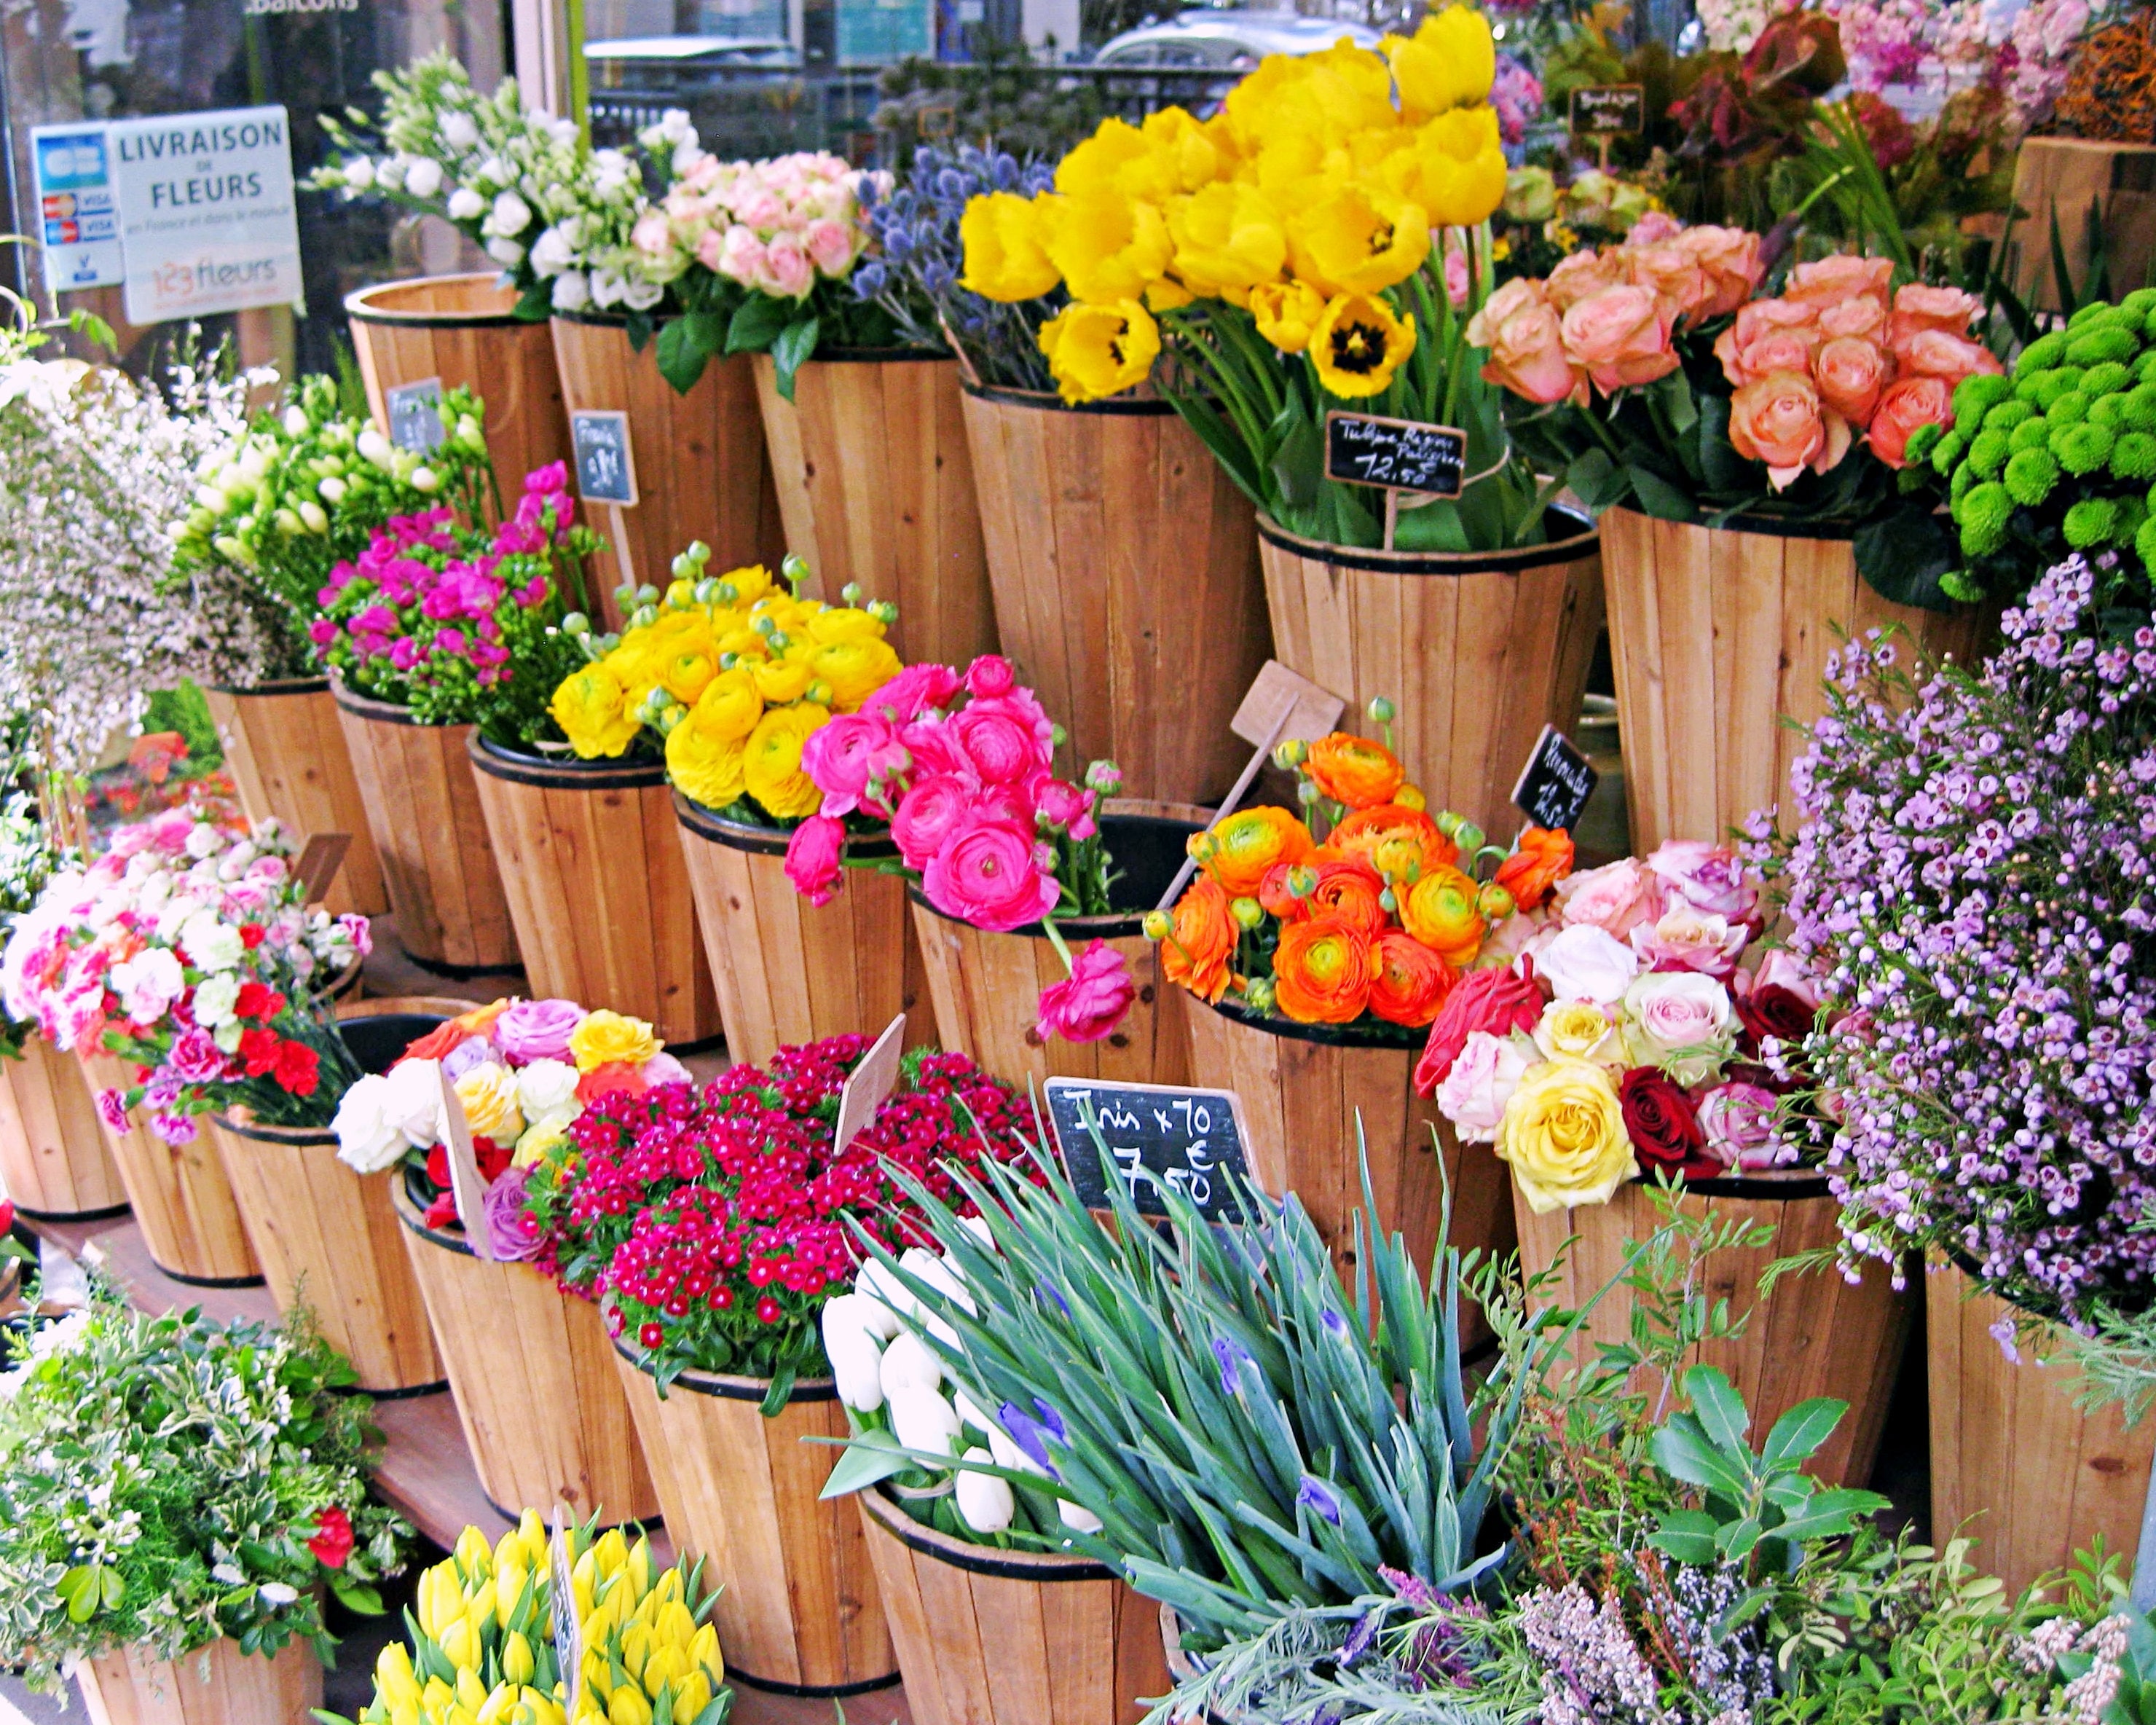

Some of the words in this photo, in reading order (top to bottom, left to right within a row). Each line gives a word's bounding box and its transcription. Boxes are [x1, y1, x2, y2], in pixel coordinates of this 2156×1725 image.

[119, 122, 282, 162] LIVRAISON
[152, 171, 262, 209] FLEURS
[152, 256, 278, 297] 123fleurs
[1063, 1089, 1141, 1131] Iris
